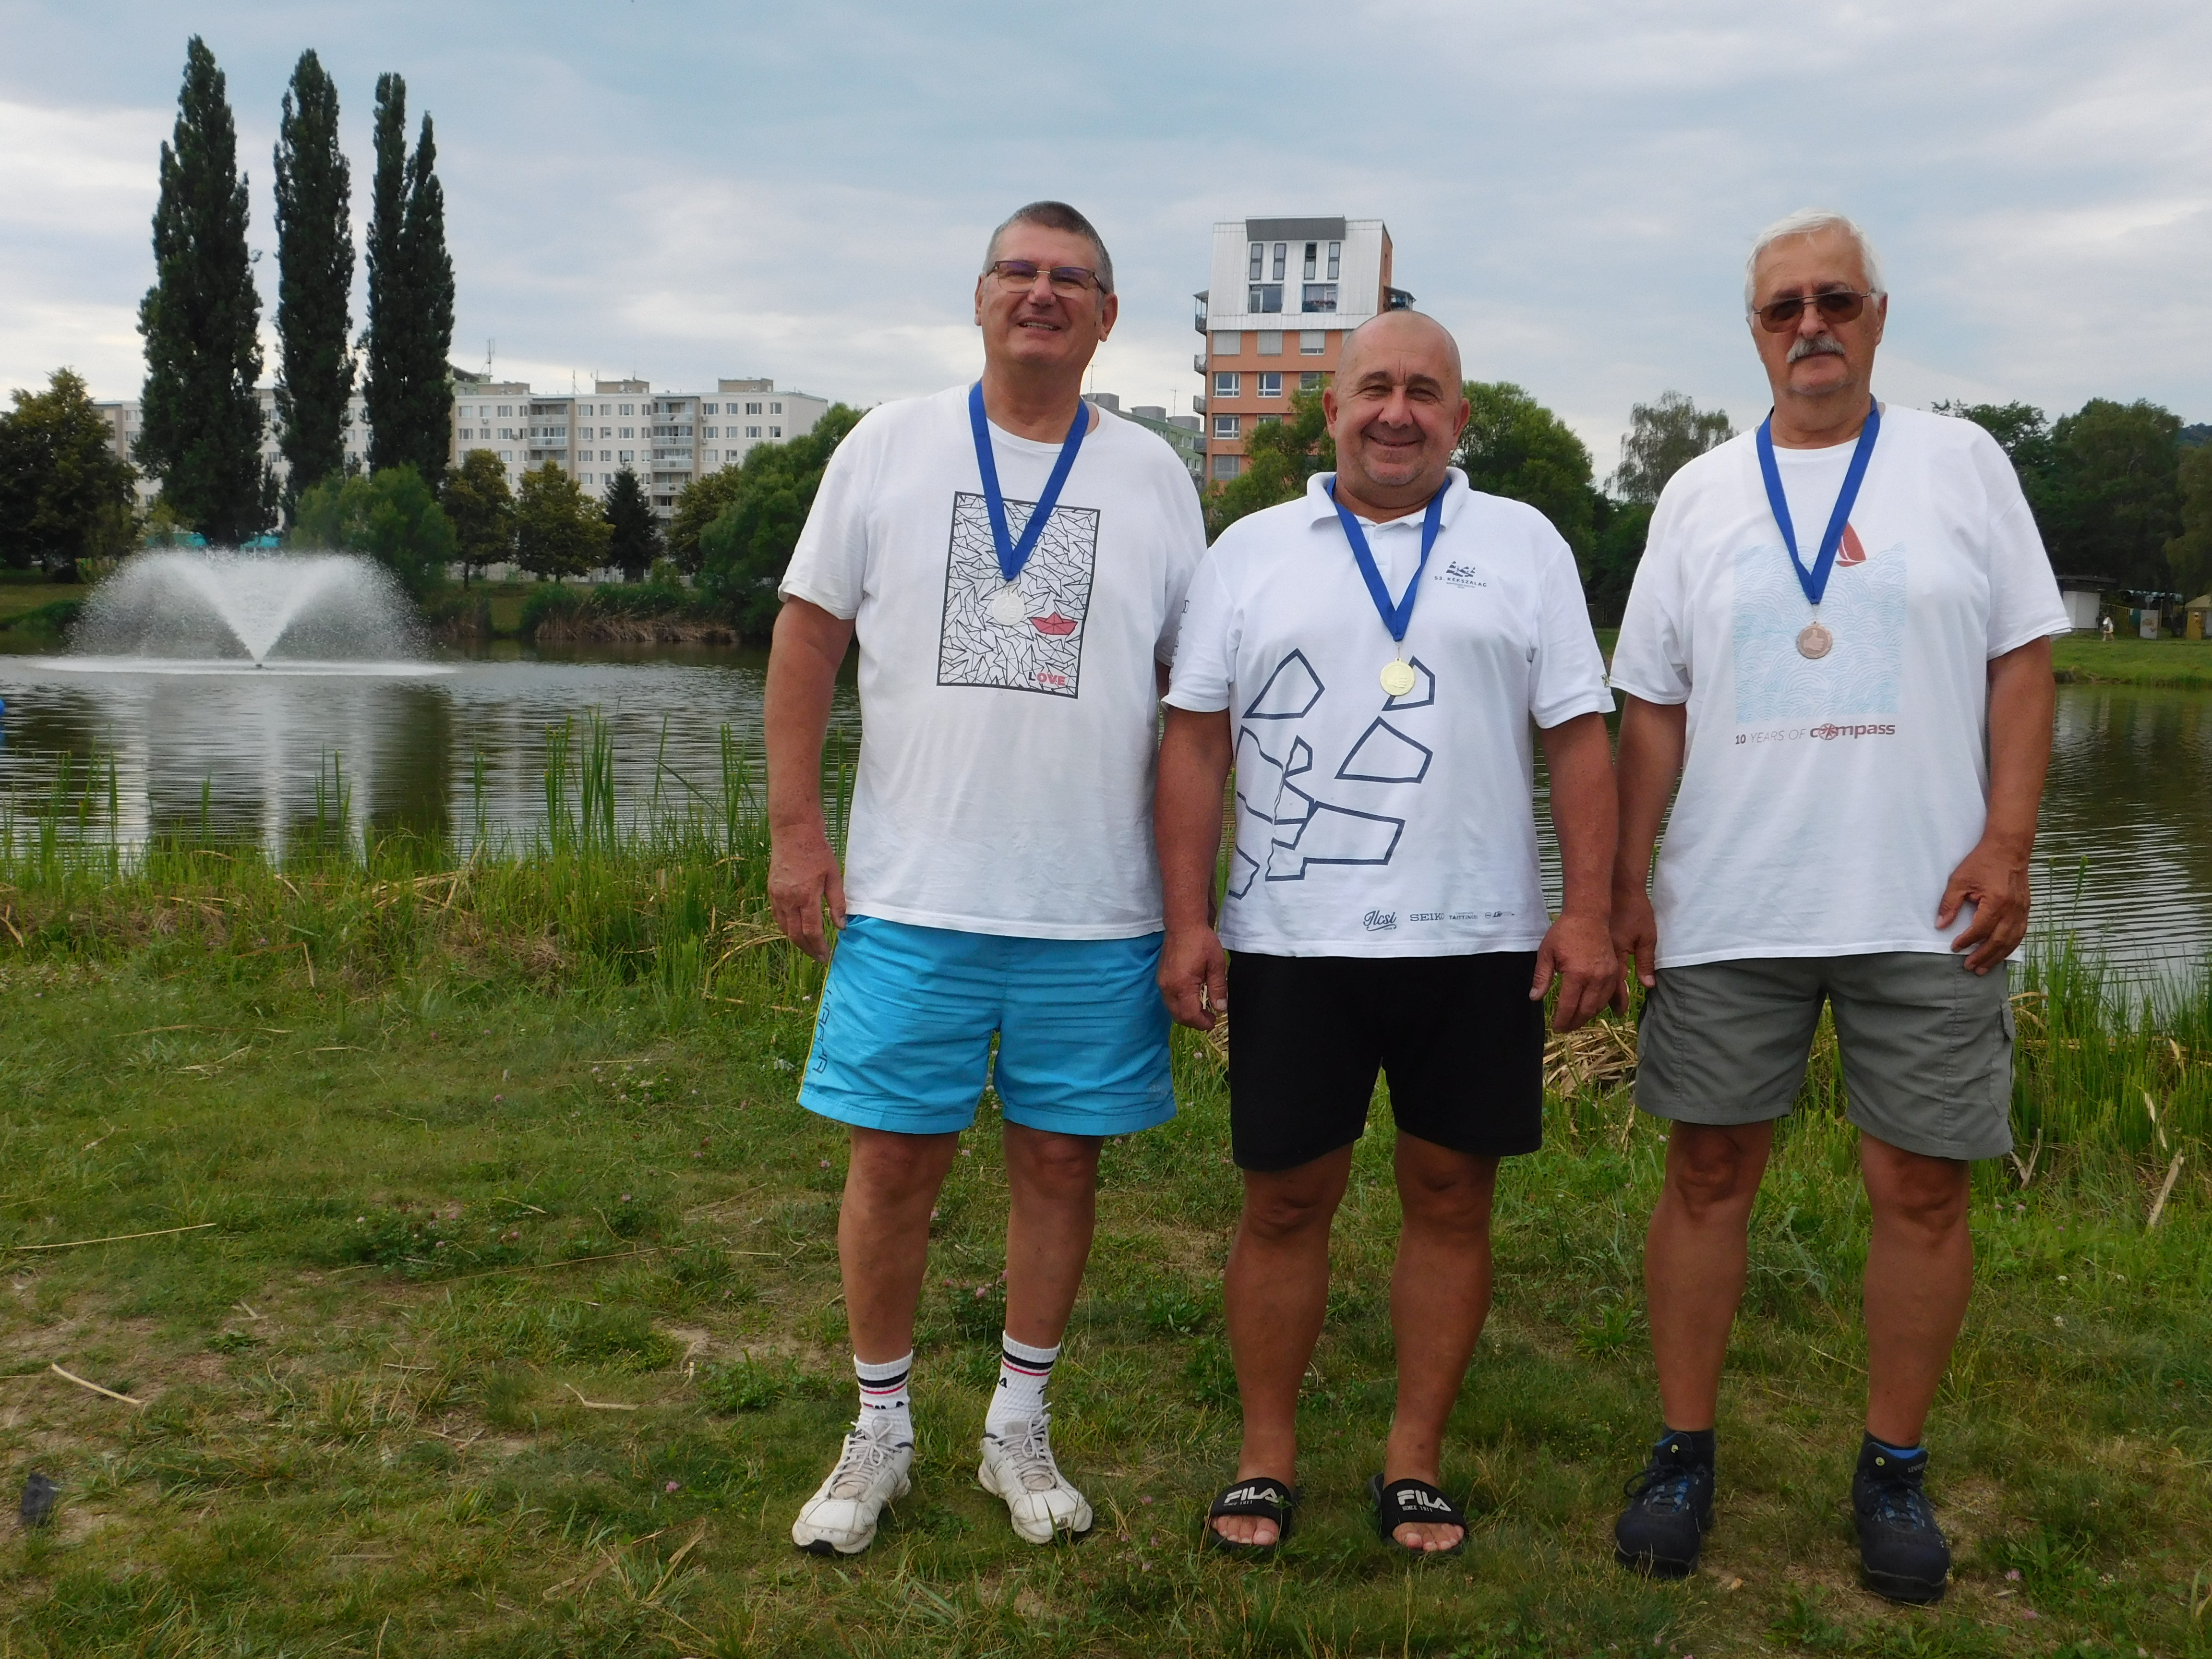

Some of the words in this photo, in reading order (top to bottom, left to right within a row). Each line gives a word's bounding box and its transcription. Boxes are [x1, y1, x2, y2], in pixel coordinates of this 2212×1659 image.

[1028, 672, 1065, 686] LOVE
[1735, 734, 1746, 745] 10
[1750, 730, 1785, 743] YEARS
[1789, 729, 1806, 740] OF
[1410, 913, 1444, 921] SEIKO
[1224, 1487, 1279, 1503] FILA
[1396, 1490, 1452, 1512] FILA
